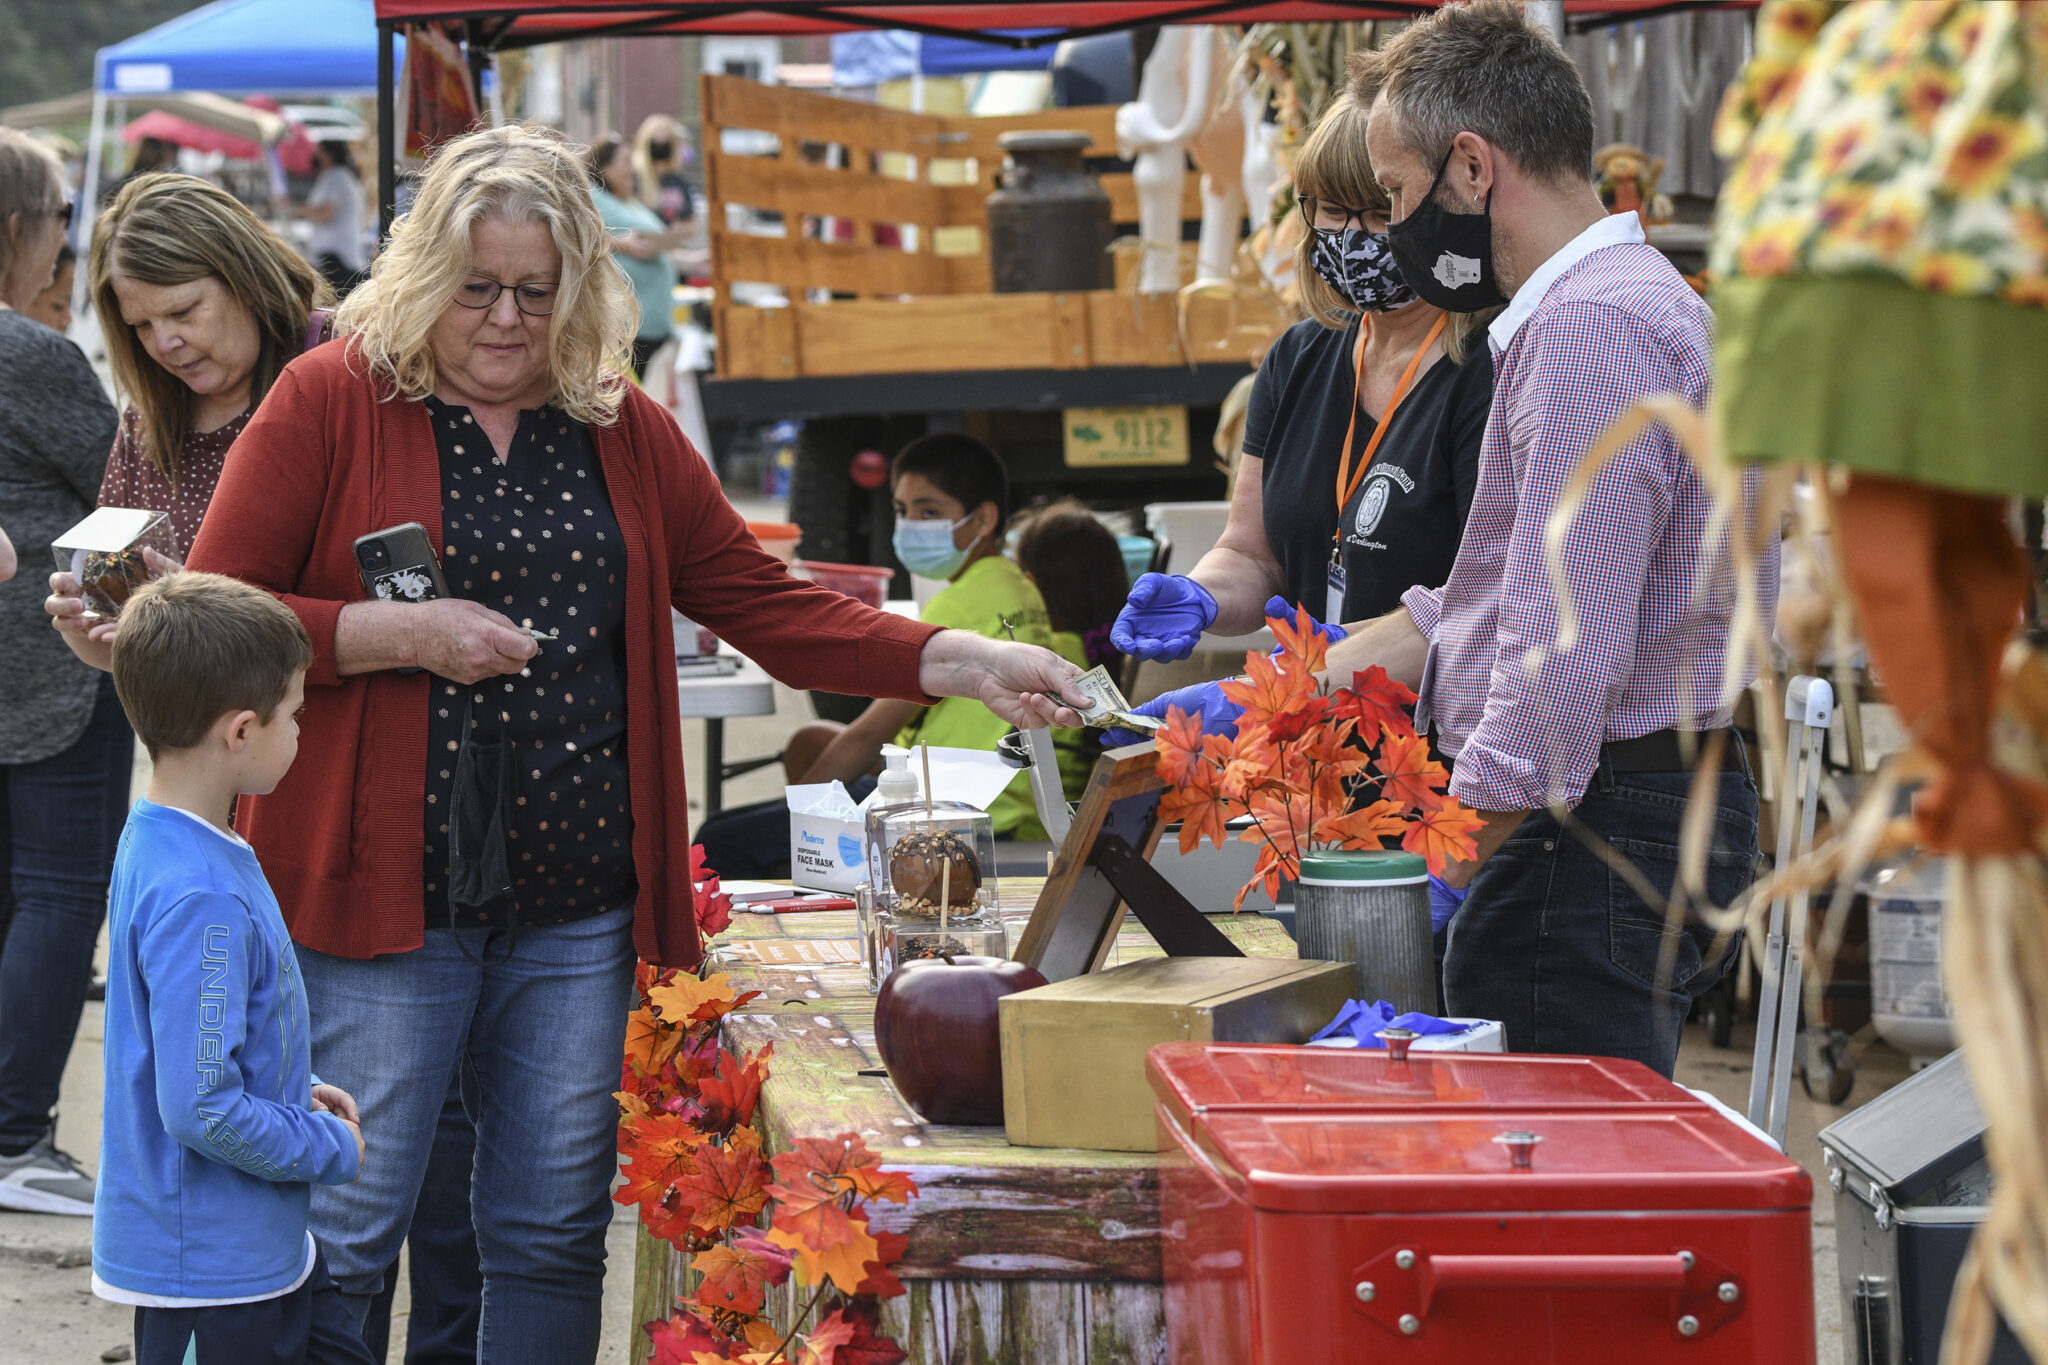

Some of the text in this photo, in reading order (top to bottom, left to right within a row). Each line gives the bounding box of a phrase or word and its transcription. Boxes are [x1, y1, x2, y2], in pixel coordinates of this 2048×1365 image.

[1114, 418, 1172, 447] 9112
[1395, 467, 1415, 494] Bank
[1351, 534, 1387, 550] Darlington
[797, 847, 821, 856] DISPOSABLE
[797, 854, 834, 868] FACE MASK
[197, 925, 229, 1095] UNDER
